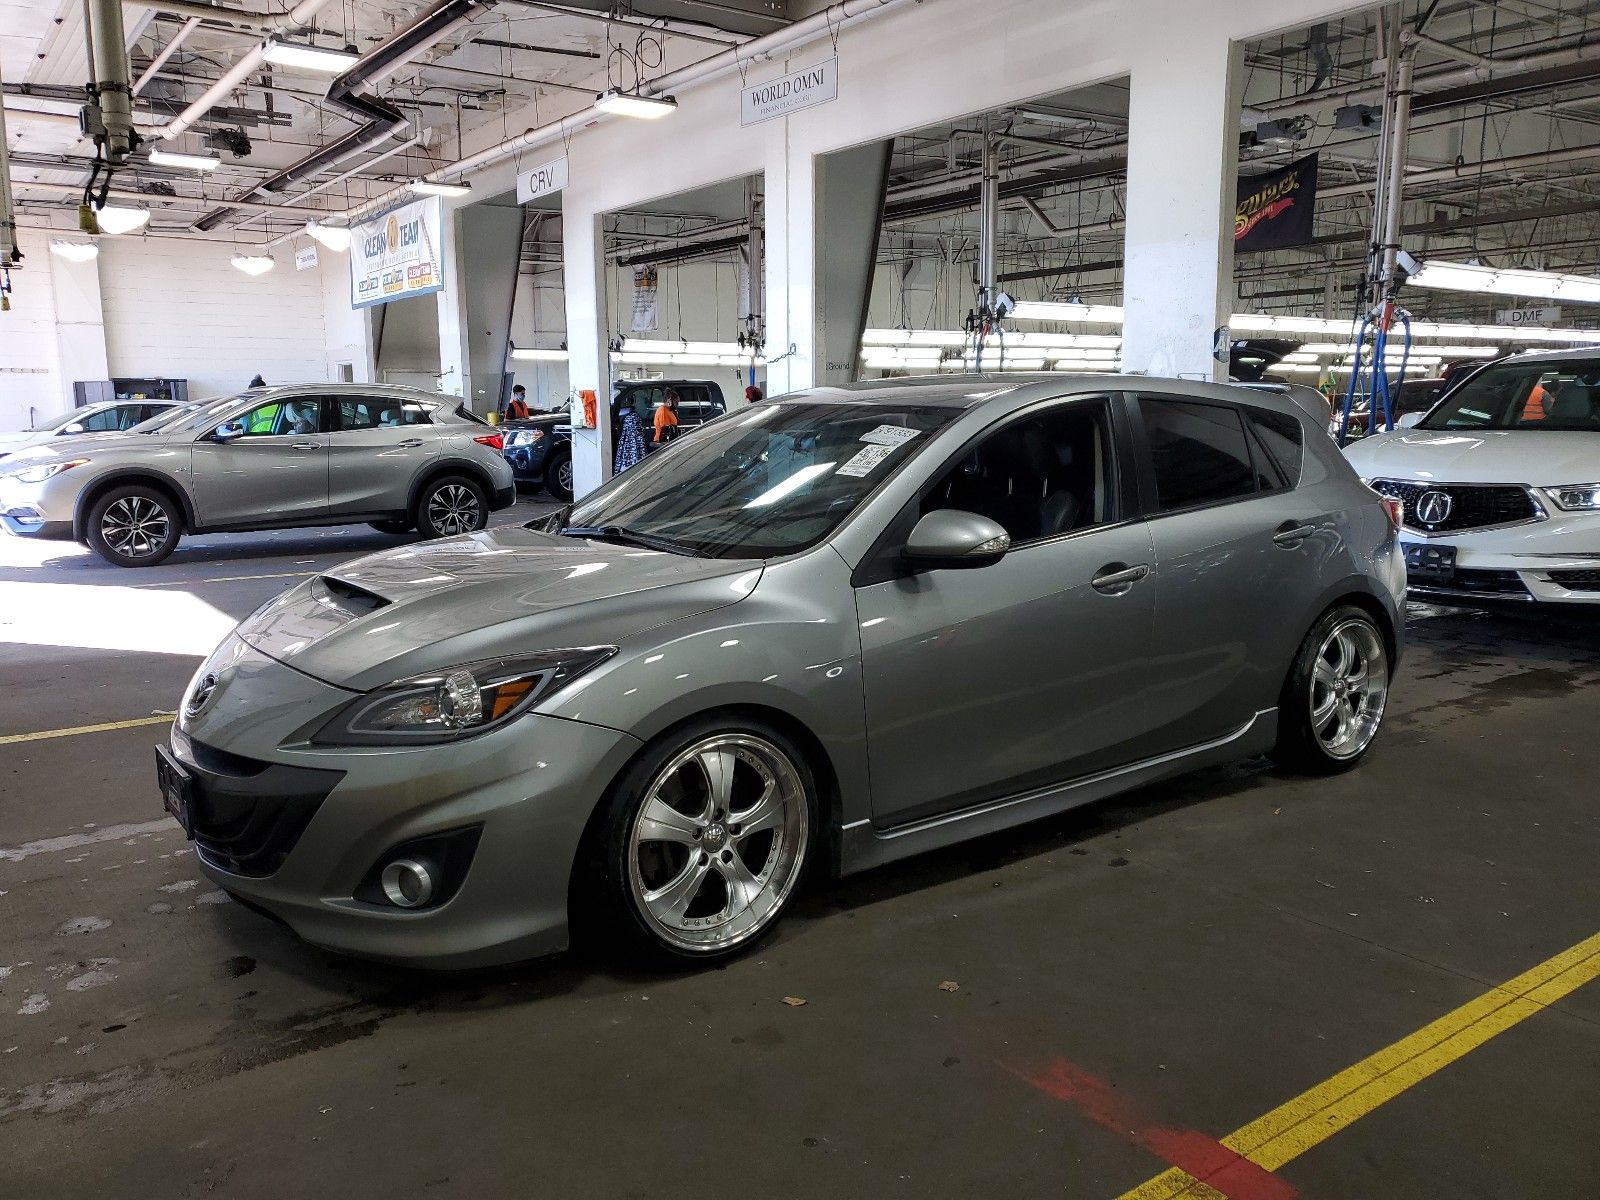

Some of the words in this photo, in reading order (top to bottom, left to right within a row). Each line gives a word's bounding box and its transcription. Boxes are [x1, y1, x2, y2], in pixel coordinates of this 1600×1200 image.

[752, 81, 791, 107] WORLD
[793, 68, 824, 94] OMNI
[530, 166, 554, 193] CRV
[364, 232, 387, 259] CLEAN
[400, 220, 418, 247] TEAM
[1512, 309, 1543, 322] DMF
[828, 361, 850, 371] Ground
